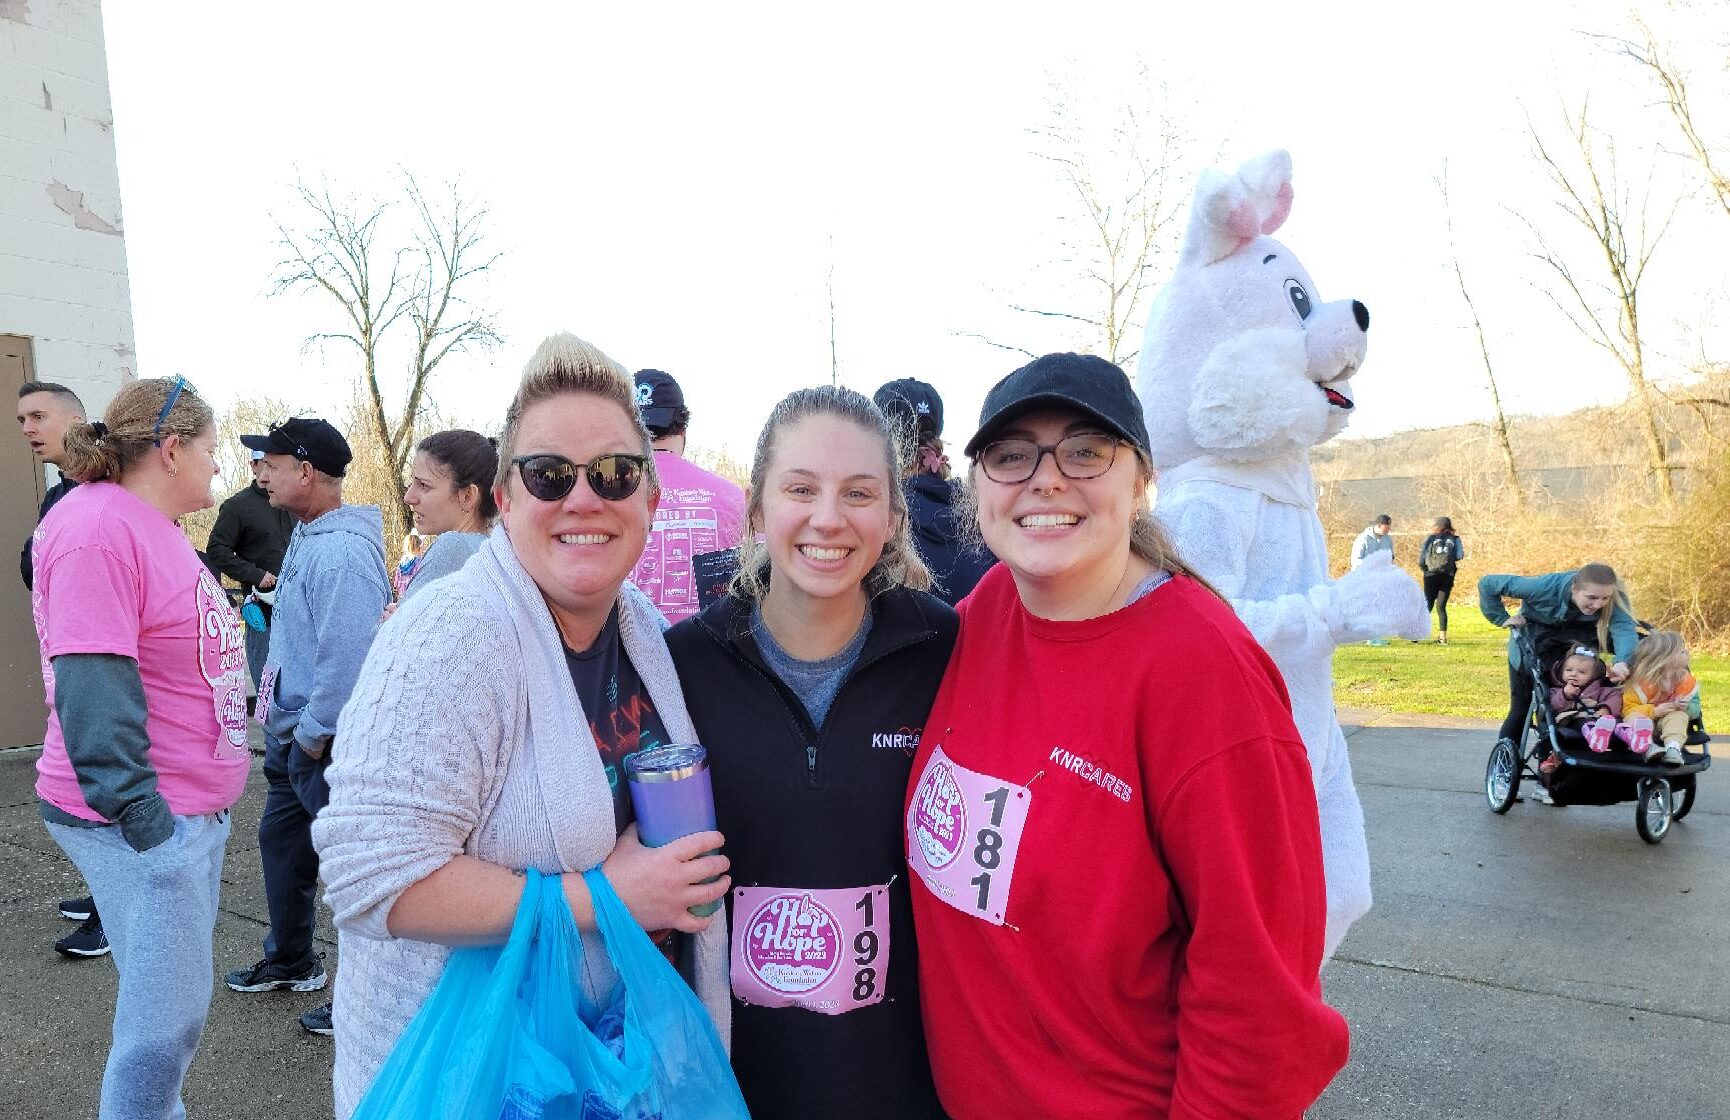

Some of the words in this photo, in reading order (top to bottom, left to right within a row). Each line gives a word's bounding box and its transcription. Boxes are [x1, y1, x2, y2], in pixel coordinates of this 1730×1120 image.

[1049, 746, 1133, 803] KNRCARES
[970, 786, 1010, 912] 181
[754, 923, 826, 961] Hope
[791, 927, 809, 938] for
[853, 891, 878, 1001] 198
